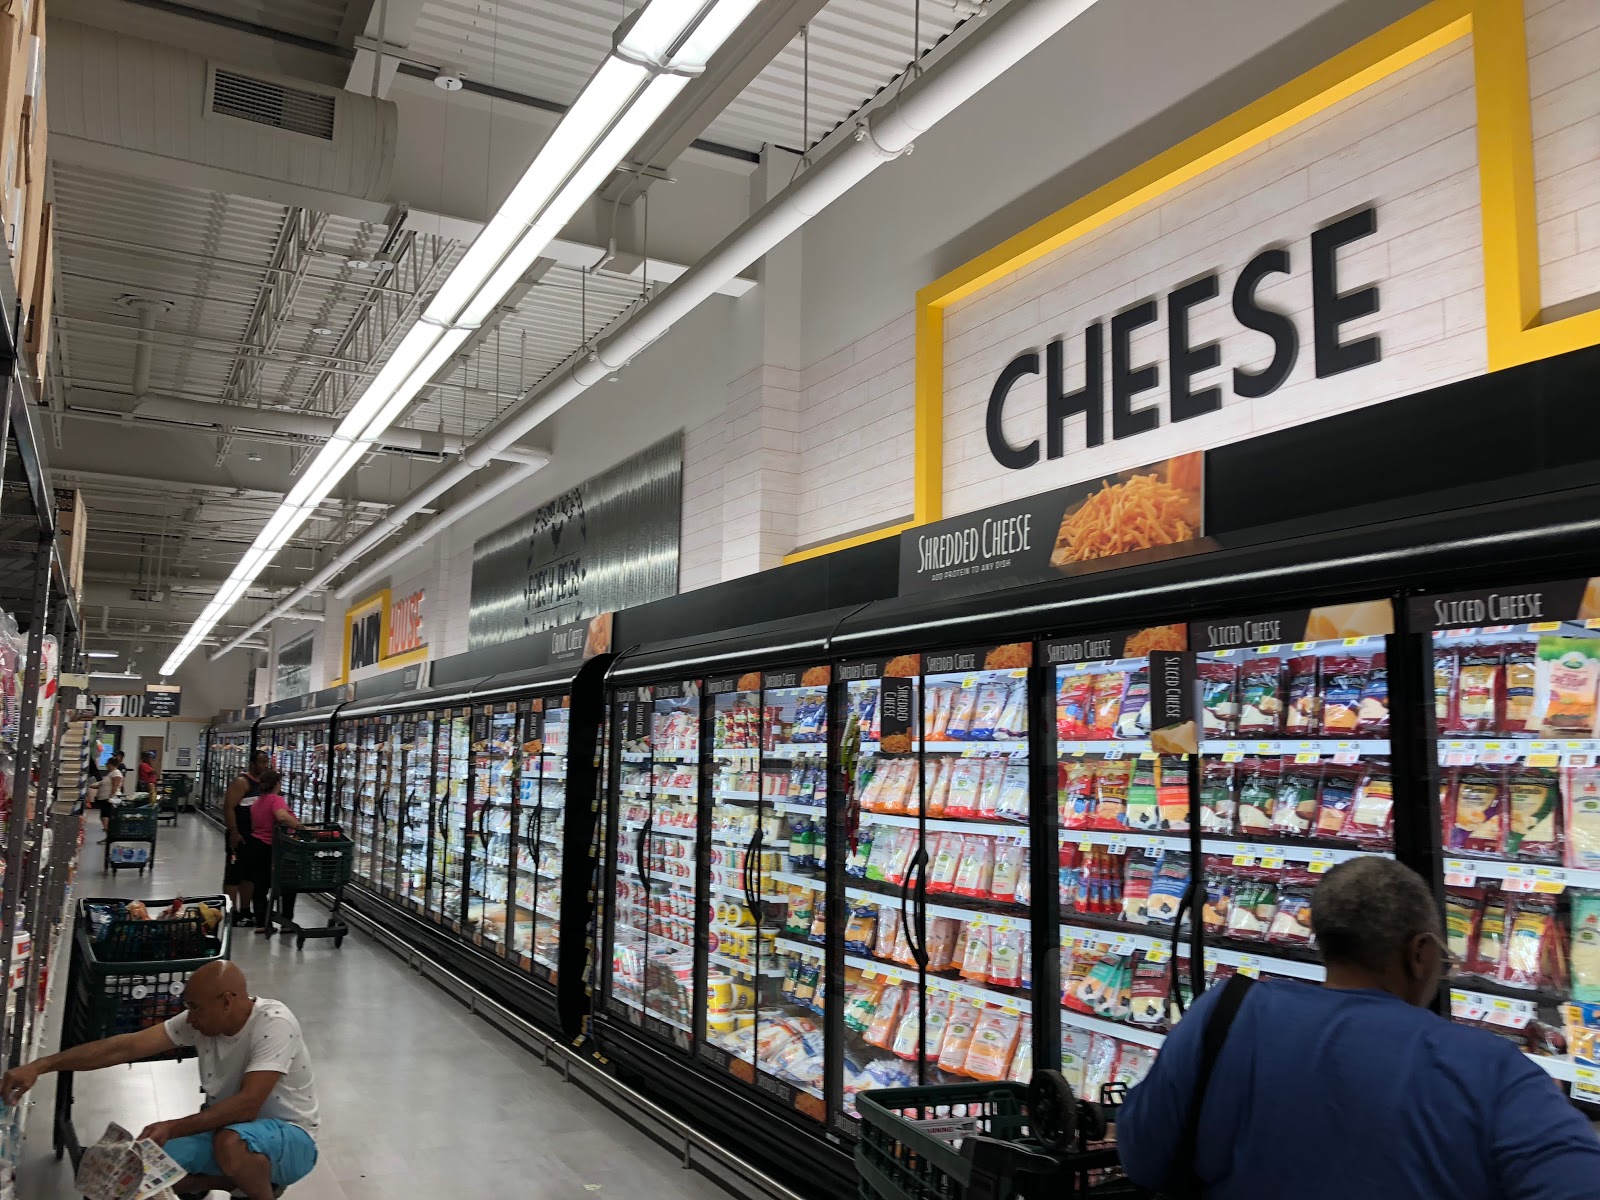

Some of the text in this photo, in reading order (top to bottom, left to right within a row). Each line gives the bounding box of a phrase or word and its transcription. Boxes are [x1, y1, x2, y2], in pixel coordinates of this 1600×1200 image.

[986, 206, 1381, 469] CHEESE
[917, 514, 1031, 573] SHREDDED CHEESE
[944, 567, 970, 579] PROTEIN
[981, 562, 994, 571] ANY
[388, 592, 423, 656] HOUSE
[1434, 593, 1544, 626] SLICED CHEESE
[1207, 620, 1281, 647] SLICED CHEESE
[926, 653, 976, 673] SHREDDED CHEESE
[1047, 639, 1111, 663] SHREDDED CHEESE
[839, 663, 877, 680] SHREDDED CHEESE
[1164, 656, 1182, 718] SLICED CHEESE
[884, 691, 897, 718] CHEESE
[896, 685, 910, 722] SHREDDED
